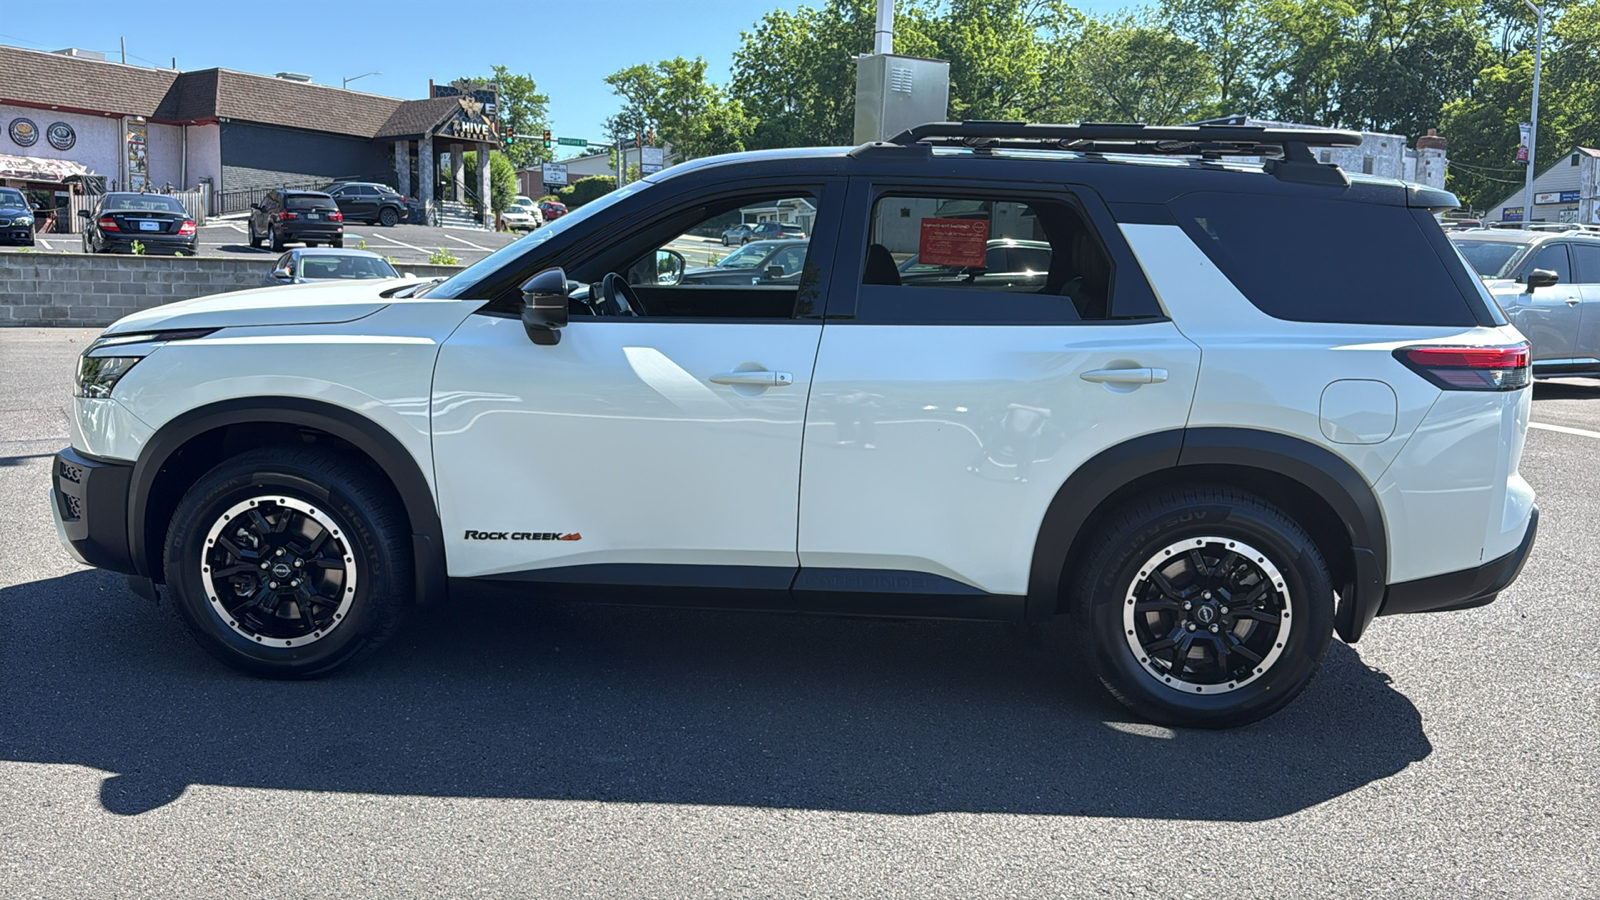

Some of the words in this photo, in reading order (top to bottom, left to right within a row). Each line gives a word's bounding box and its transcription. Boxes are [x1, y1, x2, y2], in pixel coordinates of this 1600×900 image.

[462, 121, 489, 135] HIVE
[454, 130, 489, 141] LOUNGE
[1166, 511, 1207, 527] SUV
[464, 530, 509, 540] ROCK
[511, 532, 563, 540] CREEK
